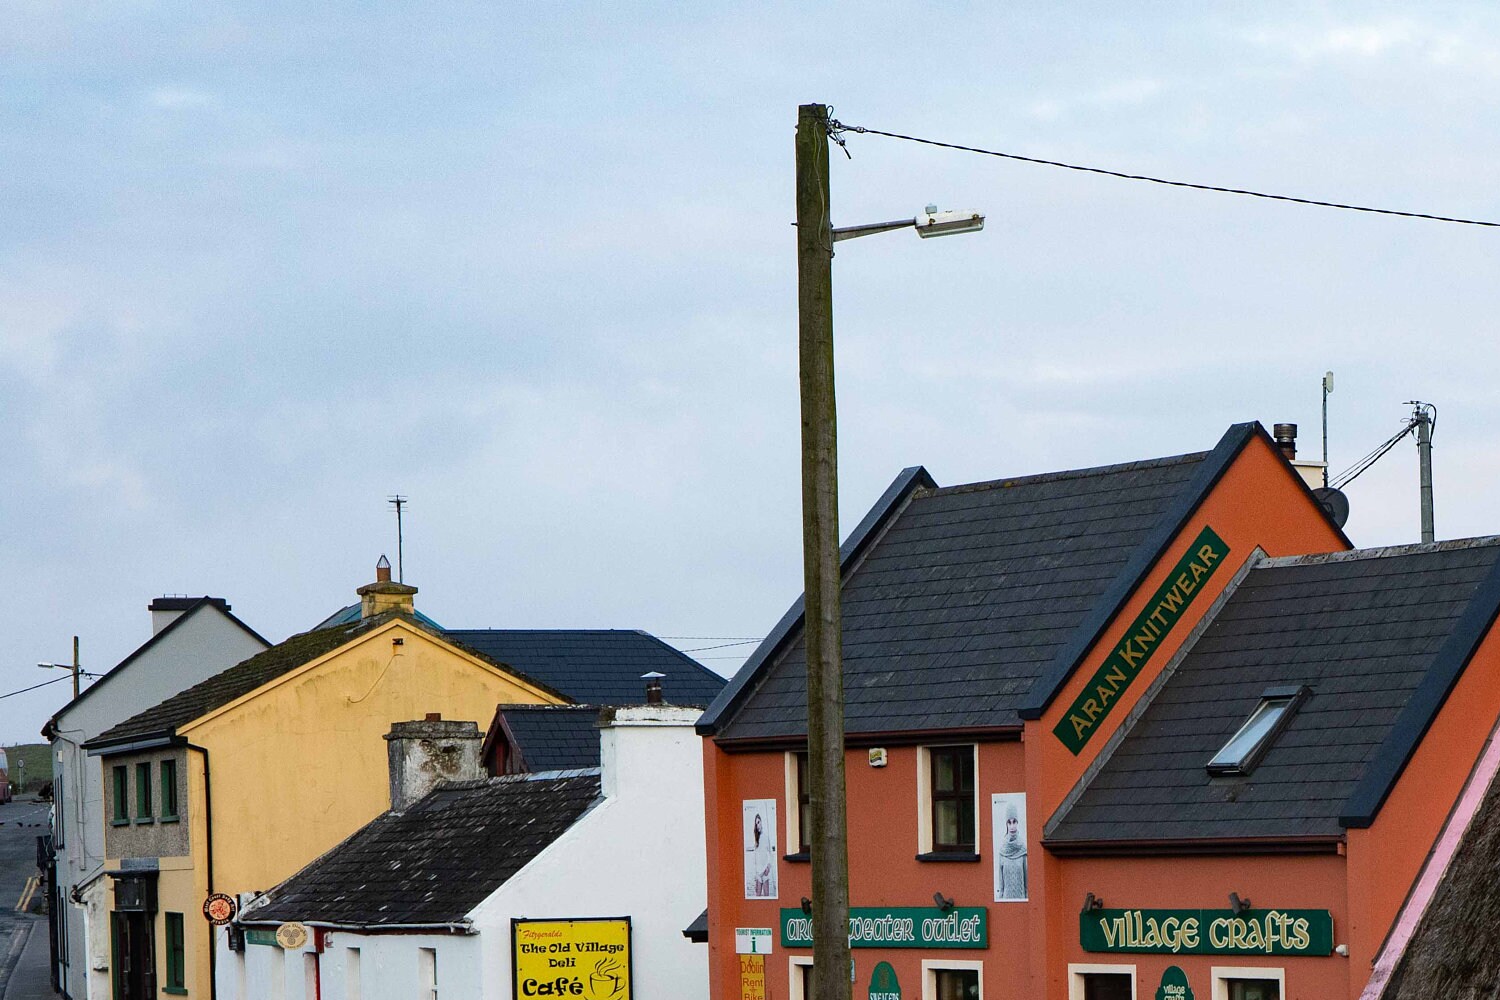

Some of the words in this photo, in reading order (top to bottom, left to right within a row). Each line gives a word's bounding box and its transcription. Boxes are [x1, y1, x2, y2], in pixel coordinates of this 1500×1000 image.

[1069, 665, 1128, 740] ARAN
[1118, 544, 1219, 669] KNITWEAR
[848, 914, 915, 941] weater
[522, 929, 563, 939] Fitzgeralds
[520, 943, 546, 954] The
[548, 943, 571, 953] Old
[574, 942, 624, 954] Village
[548, 958, 576, 968] Deli
[522, 976, 584, 997] Café
[742, 978, 763, 987] Rent
